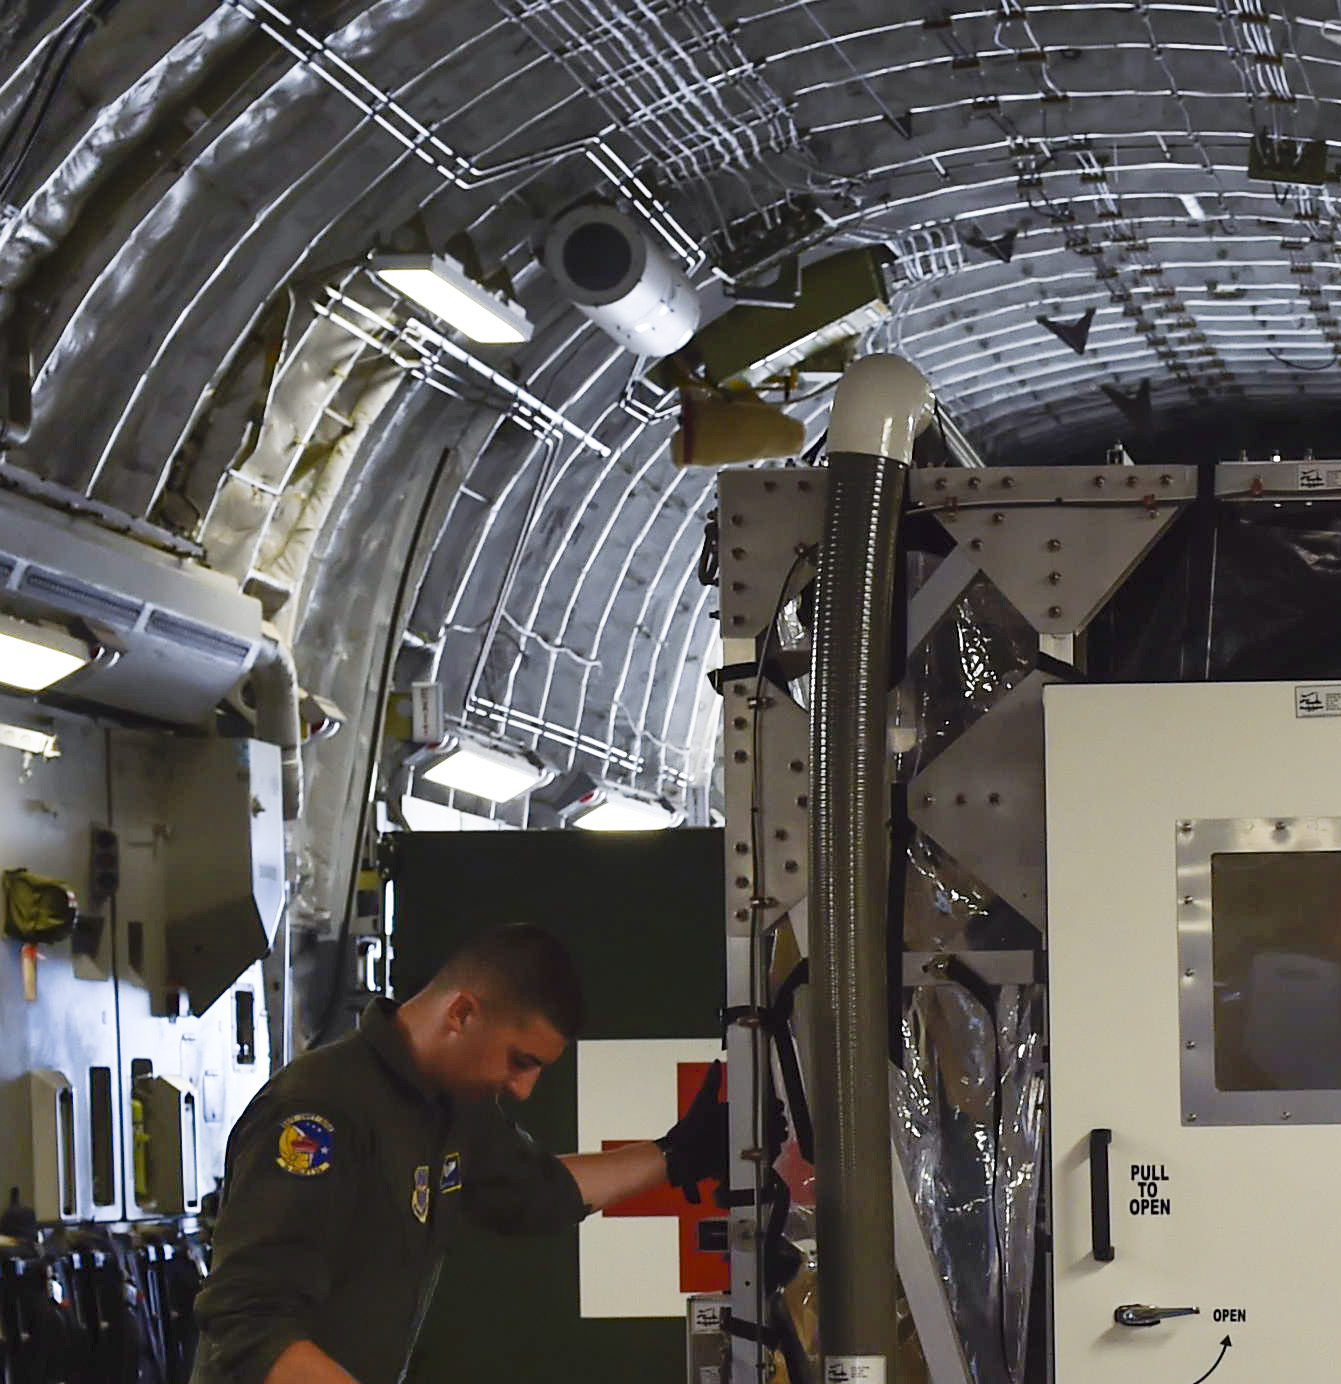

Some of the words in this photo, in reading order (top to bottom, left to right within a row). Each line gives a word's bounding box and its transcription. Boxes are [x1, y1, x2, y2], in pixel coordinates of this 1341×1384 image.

[1131, 1165, 1169, 1181] PULL
[1138, 1182, 1158, 1198] TO
[1129, 1199, 1171, 1215] OPEN
[1213, 1309, 1246, 1322] OPEN
